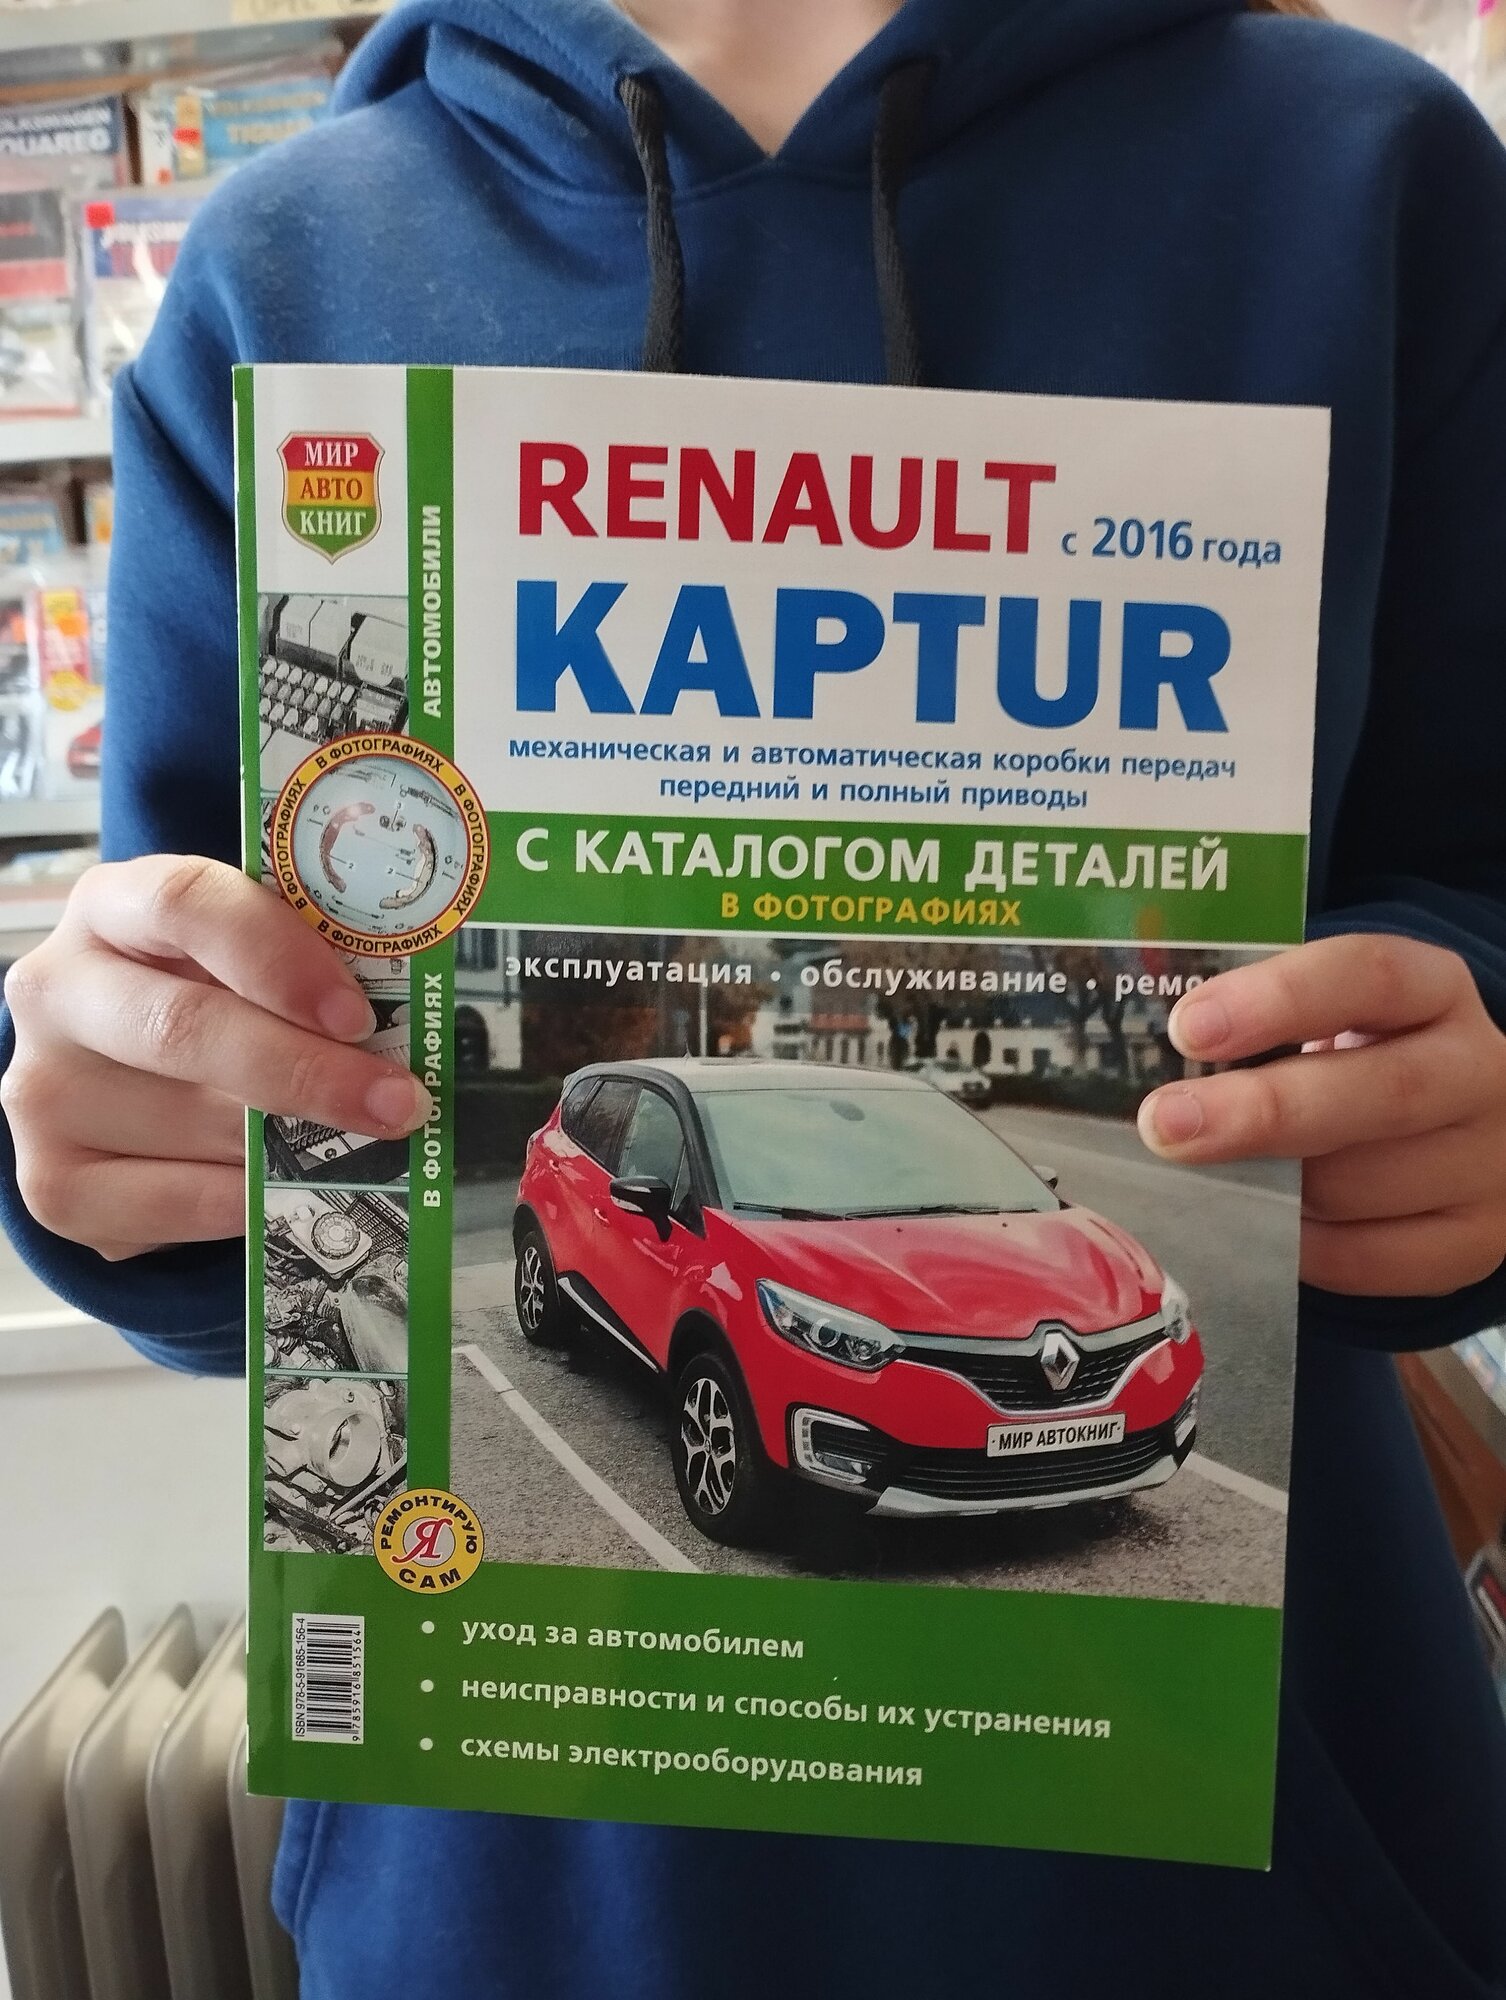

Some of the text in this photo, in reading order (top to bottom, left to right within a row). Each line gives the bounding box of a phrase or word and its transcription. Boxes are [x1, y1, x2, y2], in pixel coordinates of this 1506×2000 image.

[303, 440, 360, 467] МИР
[299, 477, 364, 502] АВТО
[518, 440, 1057, 555] RENAULT
[299, 510, 367, 536] КНИГ
[1061, 517, 1282, 569] с 2016 года
[422, 504, 442, 718] АВТОМОБИЛИ
[515, 579, 1232, 733] KAPTUR
[315, 737, 444, 774] В ФОТОГРАФИЯХ
[508, 738, 1236, 781] механическая и автоматическая коробки передач
[659, 774, 1088, 811] передний и полный приводы
[275, 778, 308, 910] В ФОТОГРАФИЯХ
[453, 783, 485, 916] В ФОТОГРАФИЯХ
[515, 827, 1229, 893] С КАТАЛОГОМ ДЕТАЛЕЙ
[721, 891, 1021, 927] В ФОТОГРАФИЯХ
[317, 919, 443, 954] В ФОТОГРАФИЯХ
[505, 954, 753, 988] эксплуатация
[800, 958, 1068, 998] обслуживание
[422, 1189, 441, 1208] В
[999, 1421, 1119, 1452] МИР АВТОКНИГ
[380, 1495, 478, 1555] РЕМОНТИРУЮ
[391, 1517, 453, 1564] Я
[398, 1567, 462, 1589] САМ
[352, 1630, 362, 1677] 851564
[461, 1619, 804, 1658] уход за автомобилем
[295, 1617, 306, 1738] ISBN 978-5-91685-156-4
[352, 1683, 361, 1729] 785916
[461, 1678, 1112, 1738] неисправности и способы их устранения
[460, 1737, 923, 1787] схемы электрооборудования
